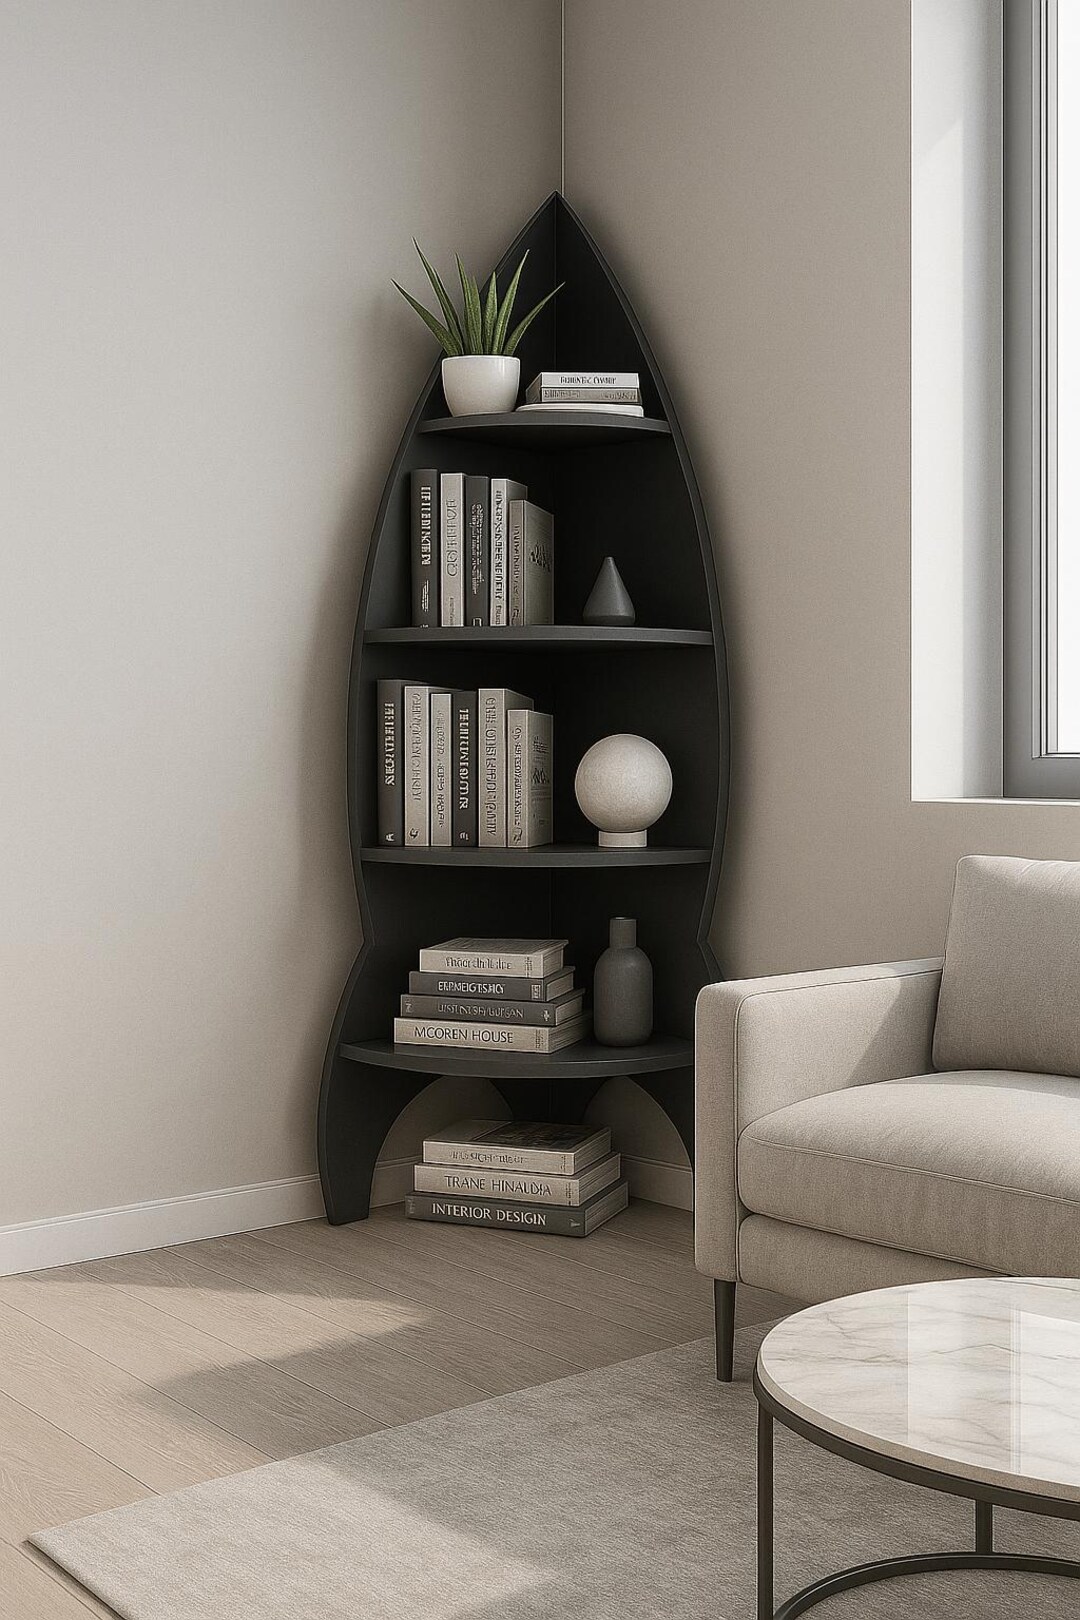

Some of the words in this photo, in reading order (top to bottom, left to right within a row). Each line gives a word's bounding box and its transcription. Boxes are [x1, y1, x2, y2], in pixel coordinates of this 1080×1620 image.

[414, 1026, 468, 1041] MCOREN
[472, 1029, 514, 1044] HOUSE
[444, 1175, 486, 1190] TRANE
[431, 1203, 492, 1220] INTERIOR
[496, 1209, 547, 1226] DESIGIN
